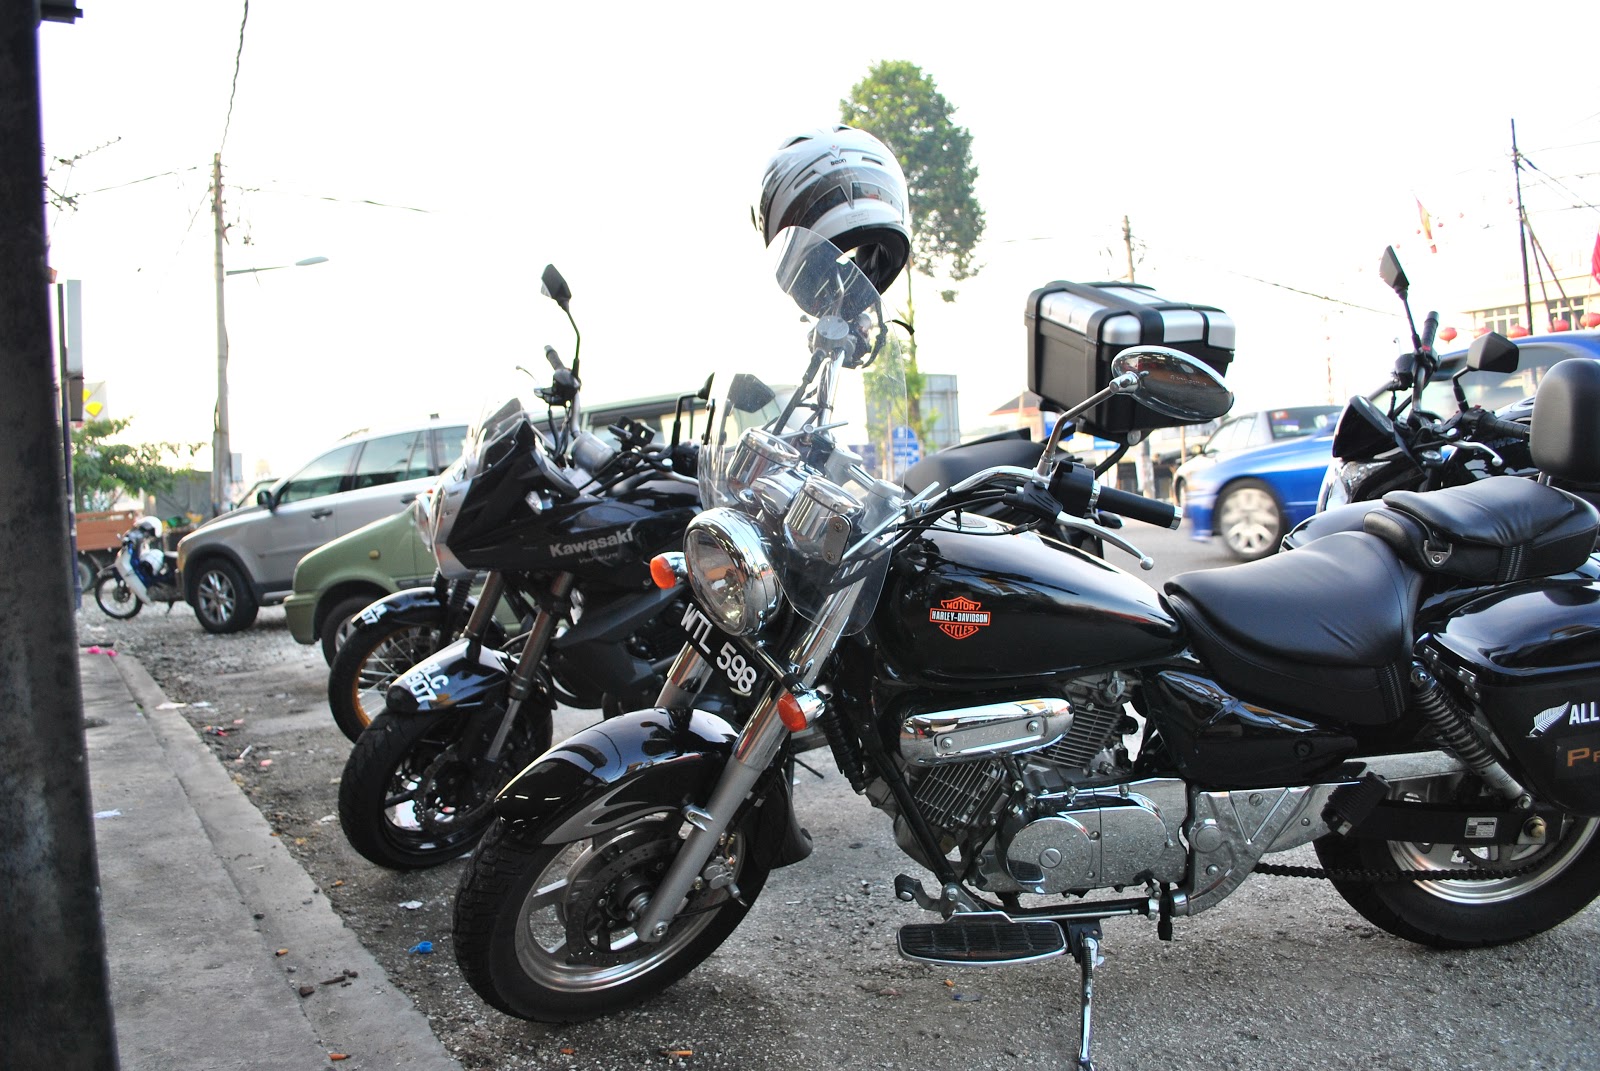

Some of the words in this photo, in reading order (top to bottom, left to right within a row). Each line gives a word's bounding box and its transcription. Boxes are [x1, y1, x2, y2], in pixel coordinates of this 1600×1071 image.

[550, 528, 634, 558] Kawasaki
[946, 599, 975, 610] MOTOR
[931, 610, 988, 623] HARLEY-DAVIDSON
[944, 624, 974, 637] CYCLES
[680, 602, 714, 655] WTL
[716, 641, 757, 693] 598
[1568, 701, 1600, 725] ALL
